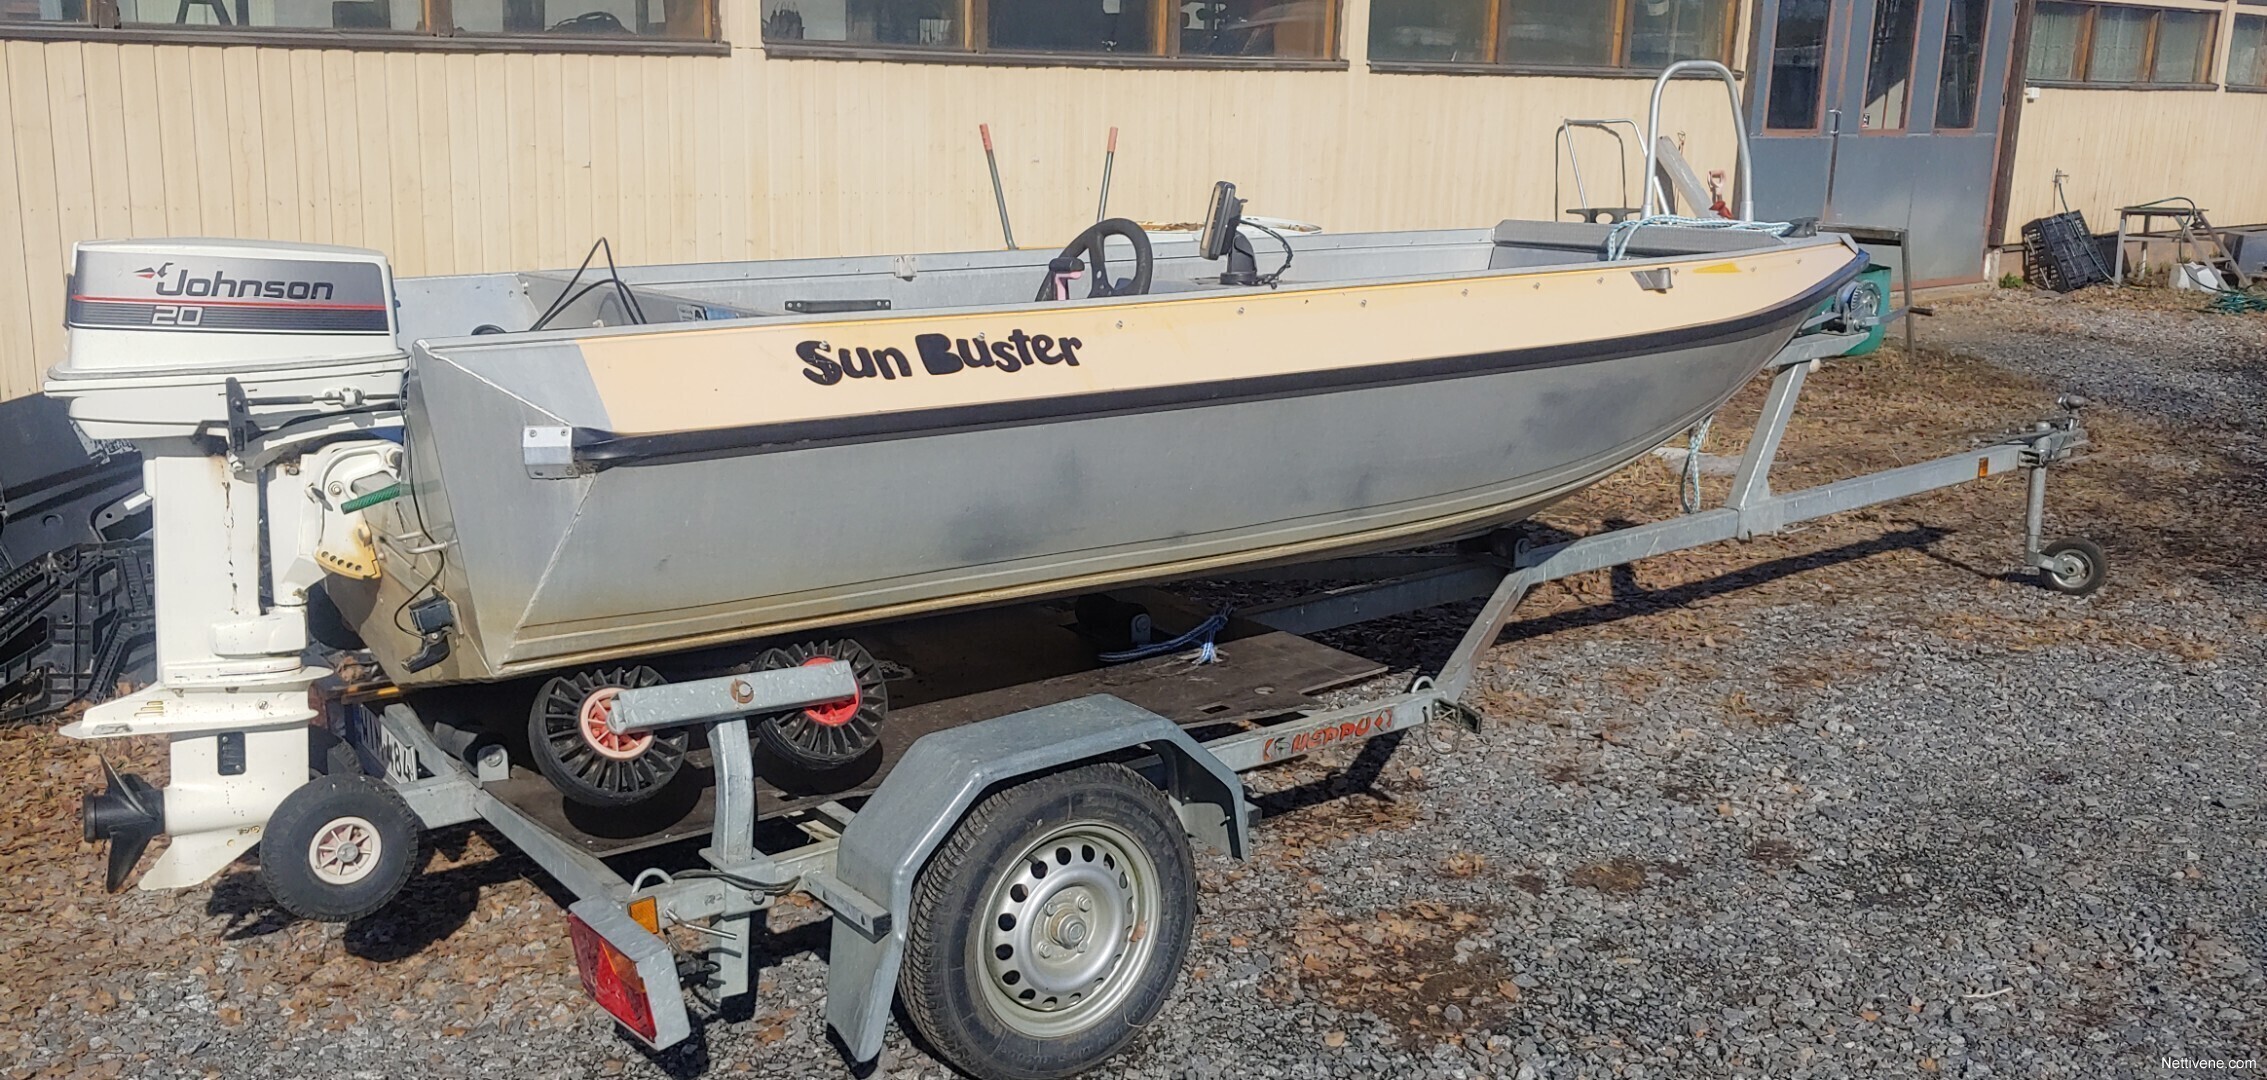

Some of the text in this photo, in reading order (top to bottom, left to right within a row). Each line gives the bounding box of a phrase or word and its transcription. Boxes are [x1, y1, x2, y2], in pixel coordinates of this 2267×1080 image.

[156, 268, 334, 300] Johnson
[152, 306, 204, 326] 20
[796, 329, 1082, 385] Sun Buster
